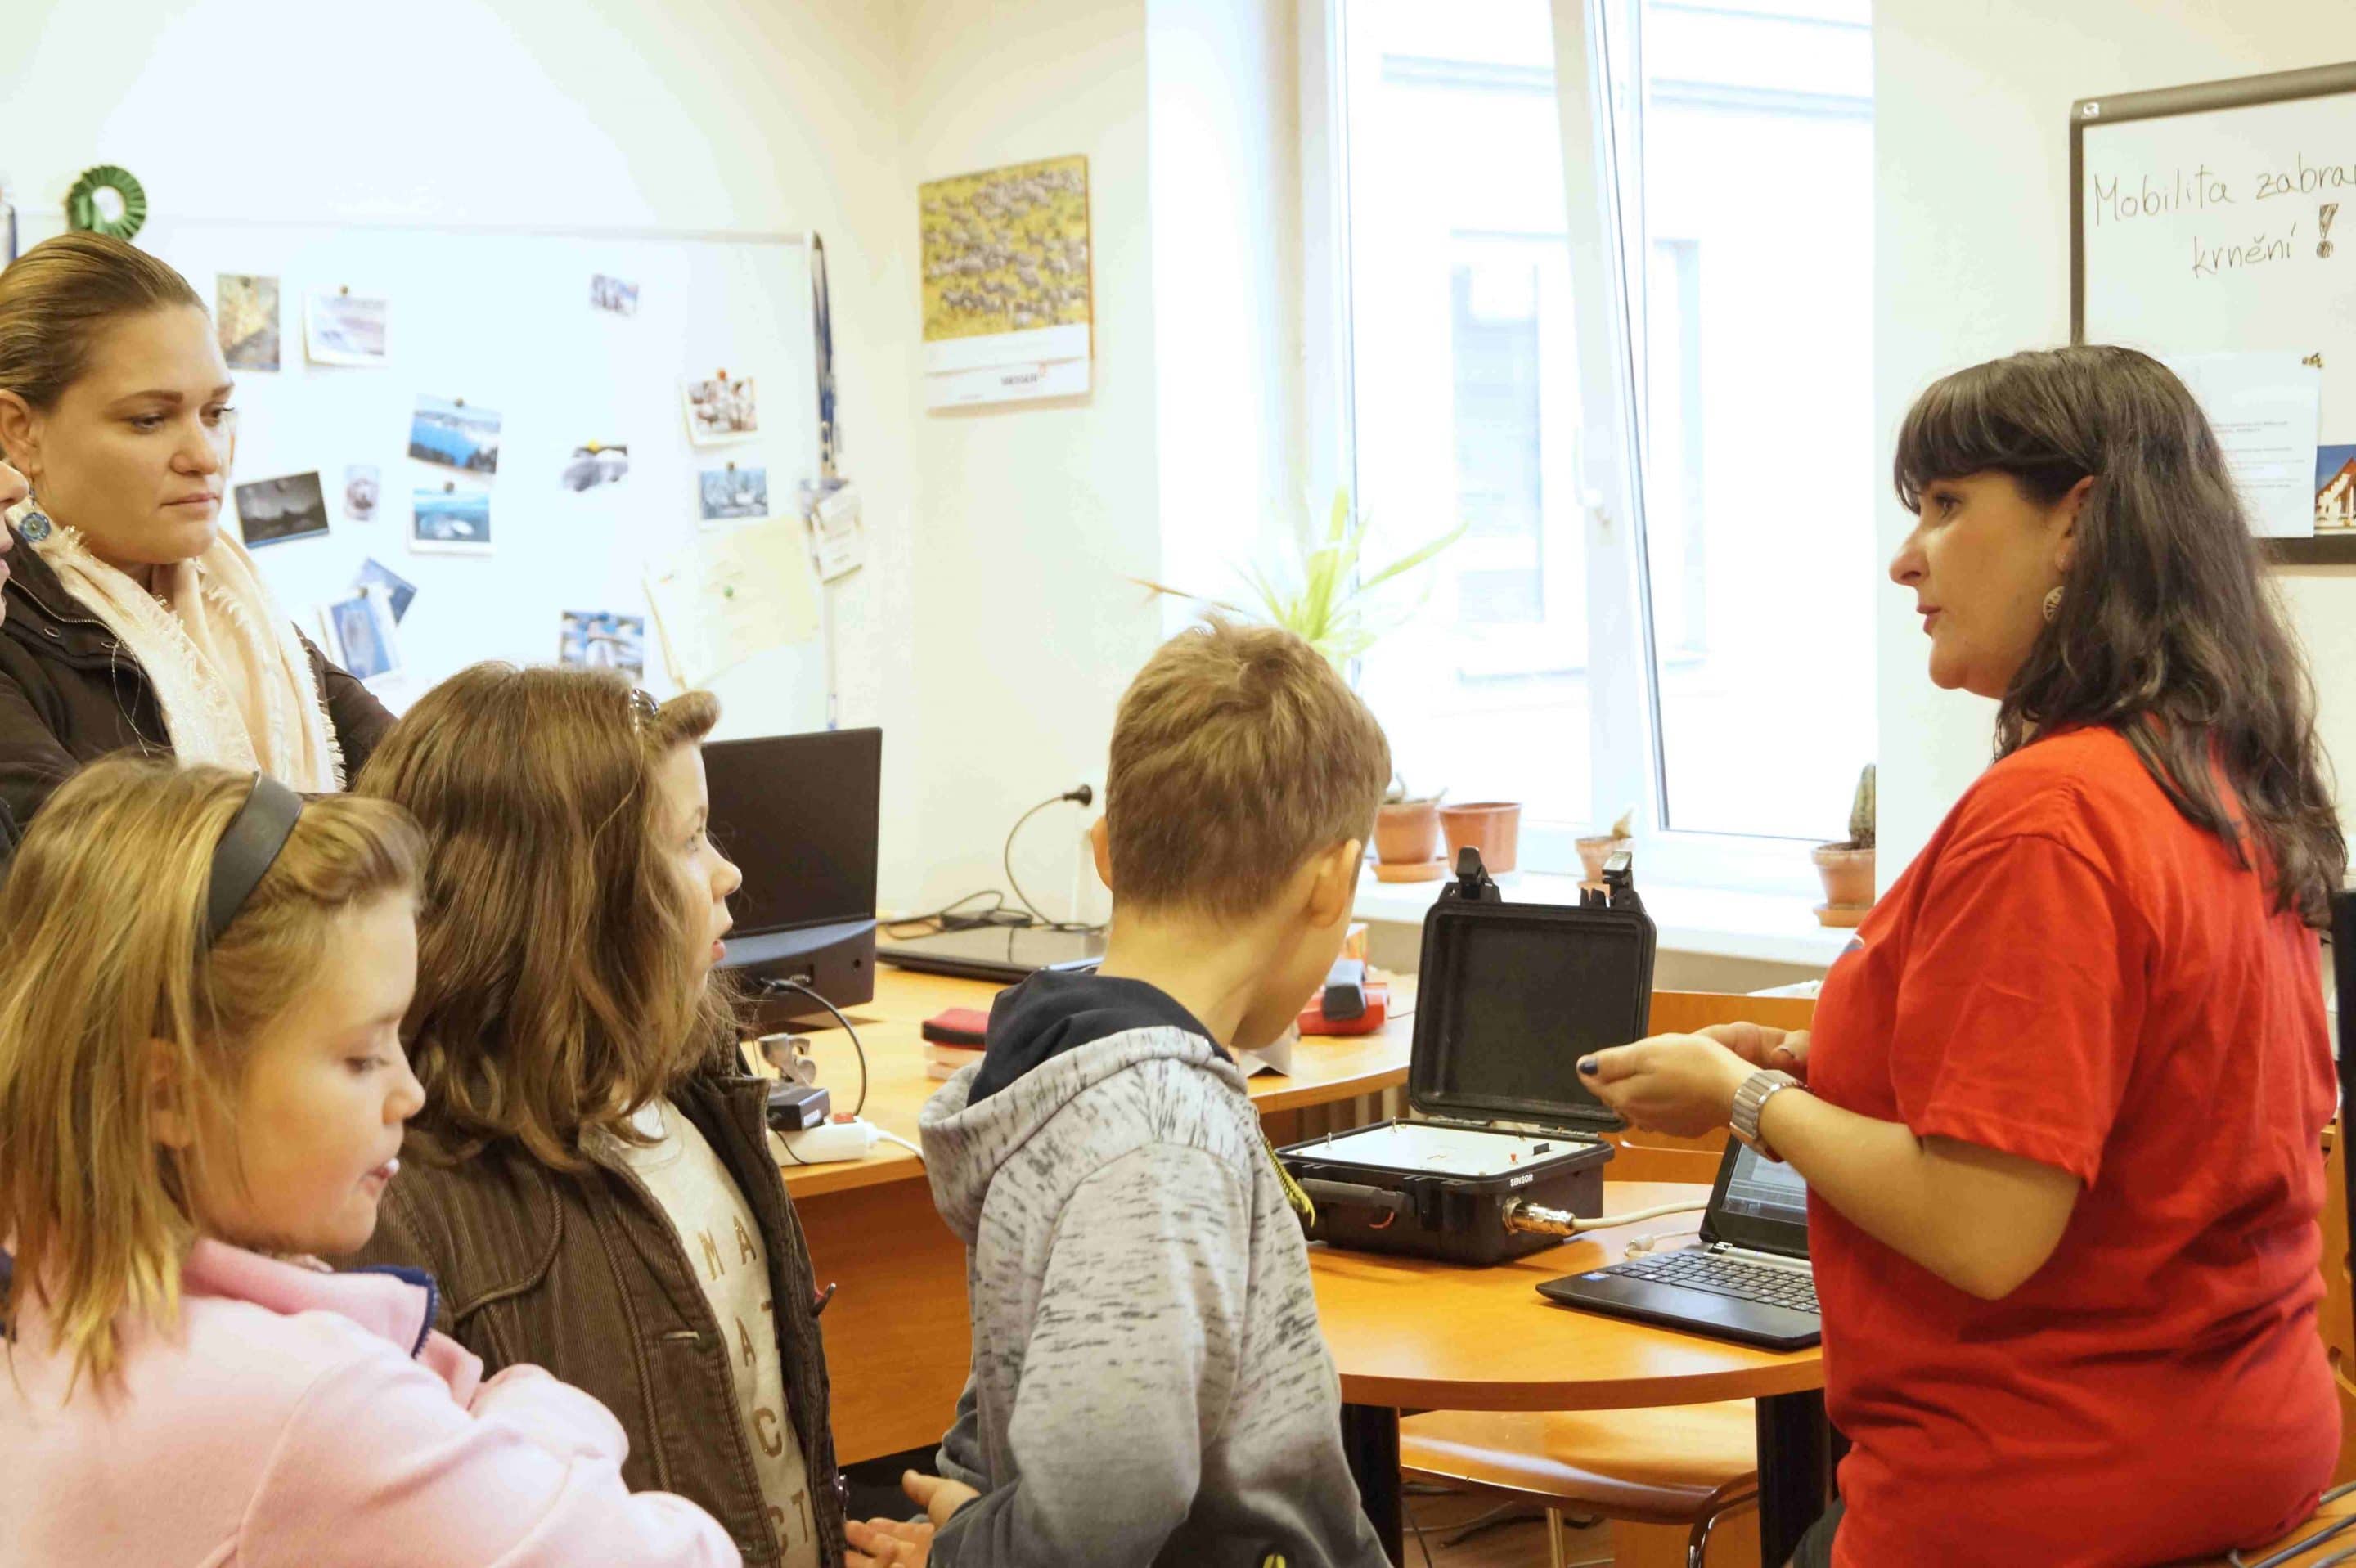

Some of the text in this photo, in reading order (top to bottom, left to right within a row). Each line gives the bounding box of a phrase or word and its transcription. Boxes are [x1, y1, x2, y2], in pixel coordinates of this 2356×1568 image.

[2094, 151, 2356, 227] Mobilita zabra
[1510, 1173, 1533, 1187] SENSOR
